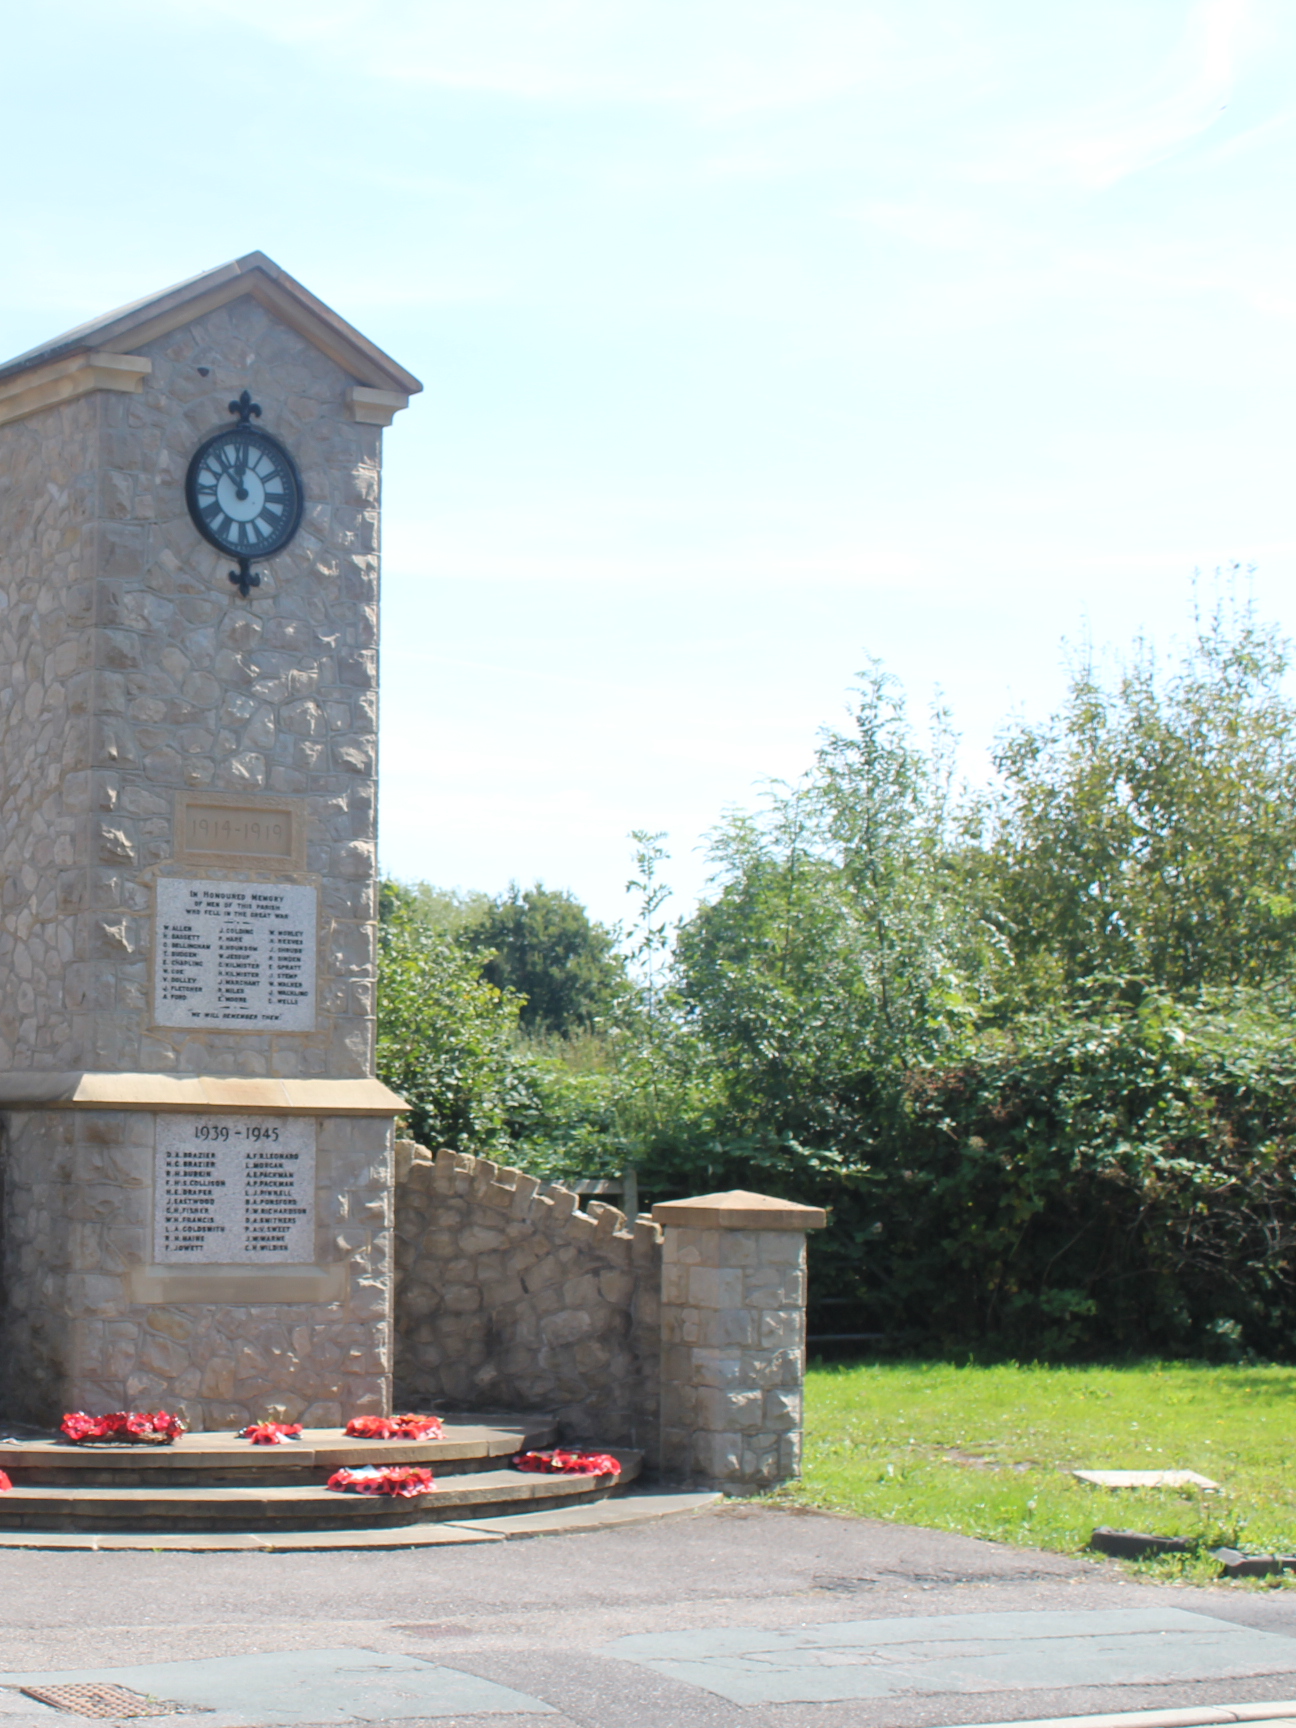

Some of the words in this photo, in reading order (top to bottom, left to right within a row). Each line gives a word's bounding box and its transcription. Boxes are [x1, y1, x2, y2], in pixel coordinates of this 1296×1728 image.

[191, 818, 282, 840] 1914-1919
[203, 892, 246, 900] HONOURED
[195, 1126, 229, 1142] 1939
[246, 1127, 279, 1142] 1945
